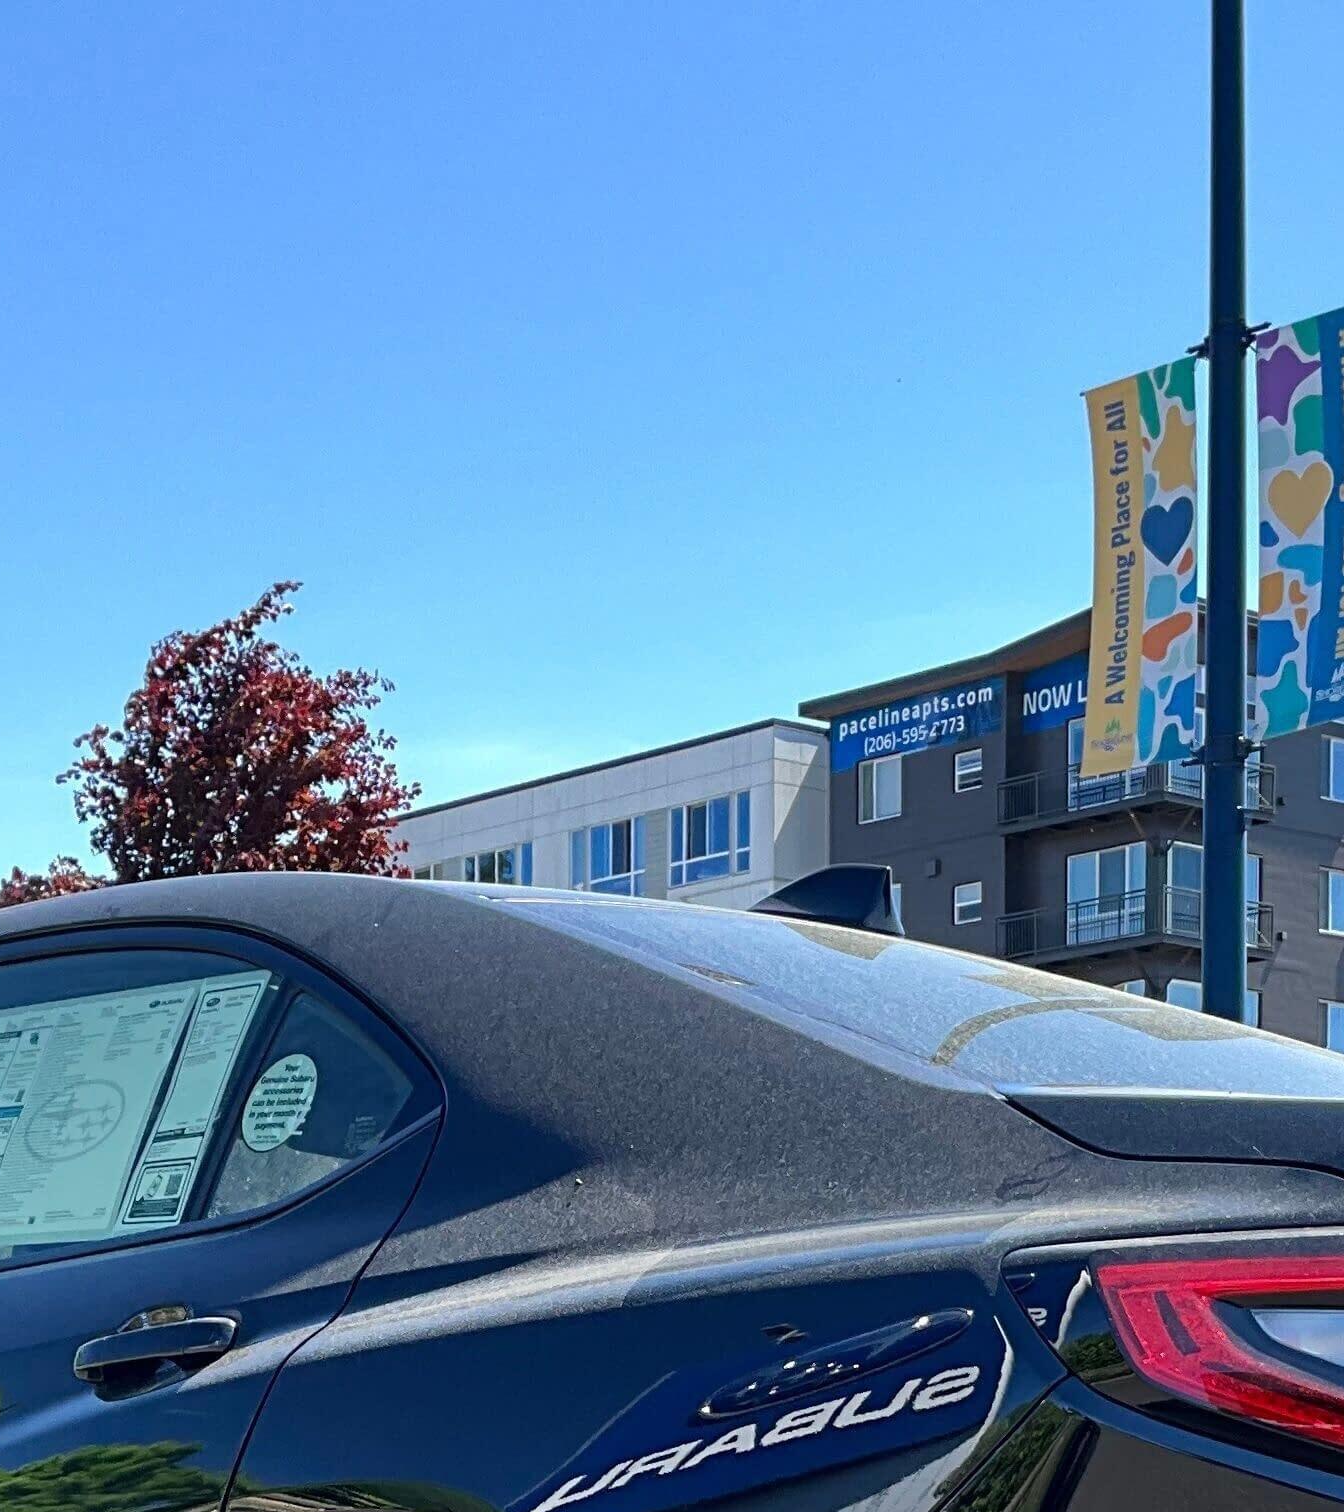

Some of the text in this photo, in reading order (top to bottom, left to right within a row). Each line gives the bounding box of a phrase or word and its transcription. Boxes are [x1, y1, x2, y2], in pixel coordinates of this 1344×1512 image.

[1104, 400, 1136, 704] A Welcoming Place for All
[839, 687, 993, 742] pacelineapts.com
[1023, 682, 1072, 716] NOW
